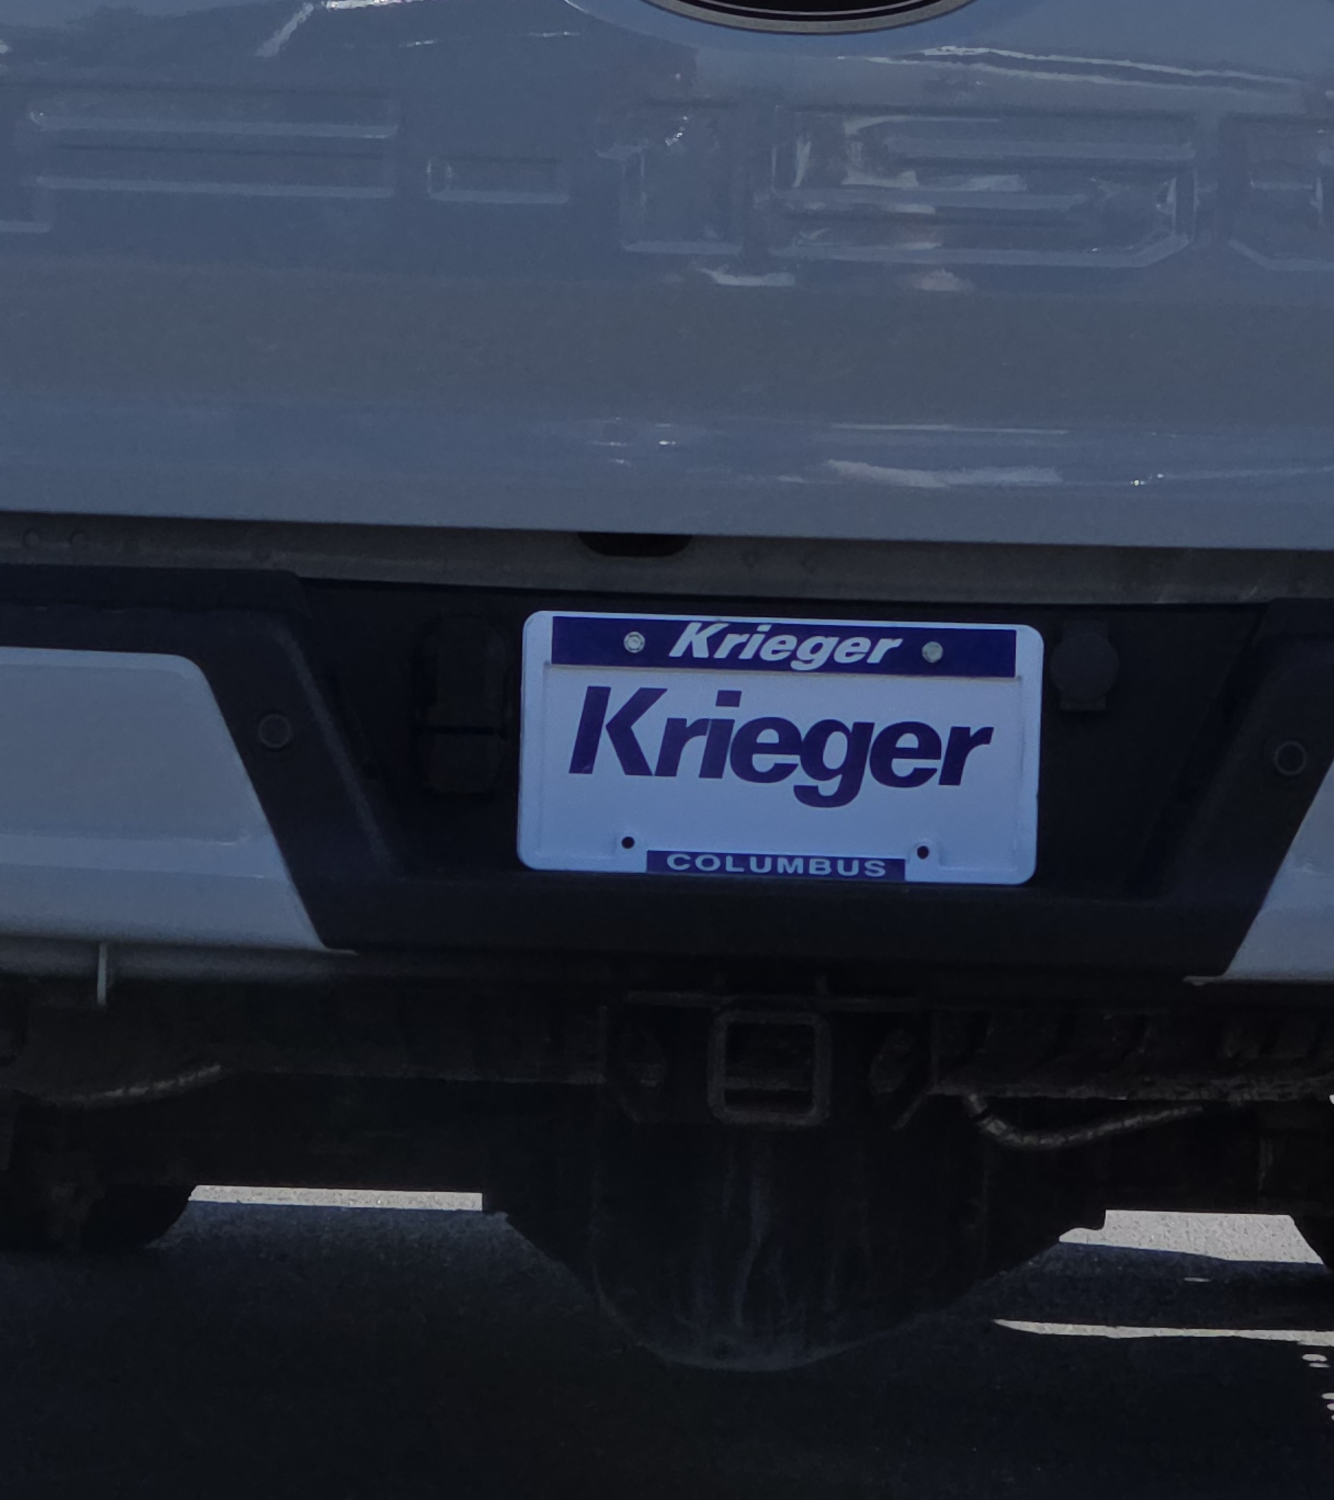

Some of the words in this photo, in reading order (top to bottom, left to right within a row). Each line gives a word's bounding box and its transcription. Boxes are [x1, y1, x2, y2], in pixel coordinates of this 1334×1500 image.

[668, 621, 903, 671] Krieger
[568, 685, 995, 808] Krieger
[667, 852, 887, 878] COLUMBUS
